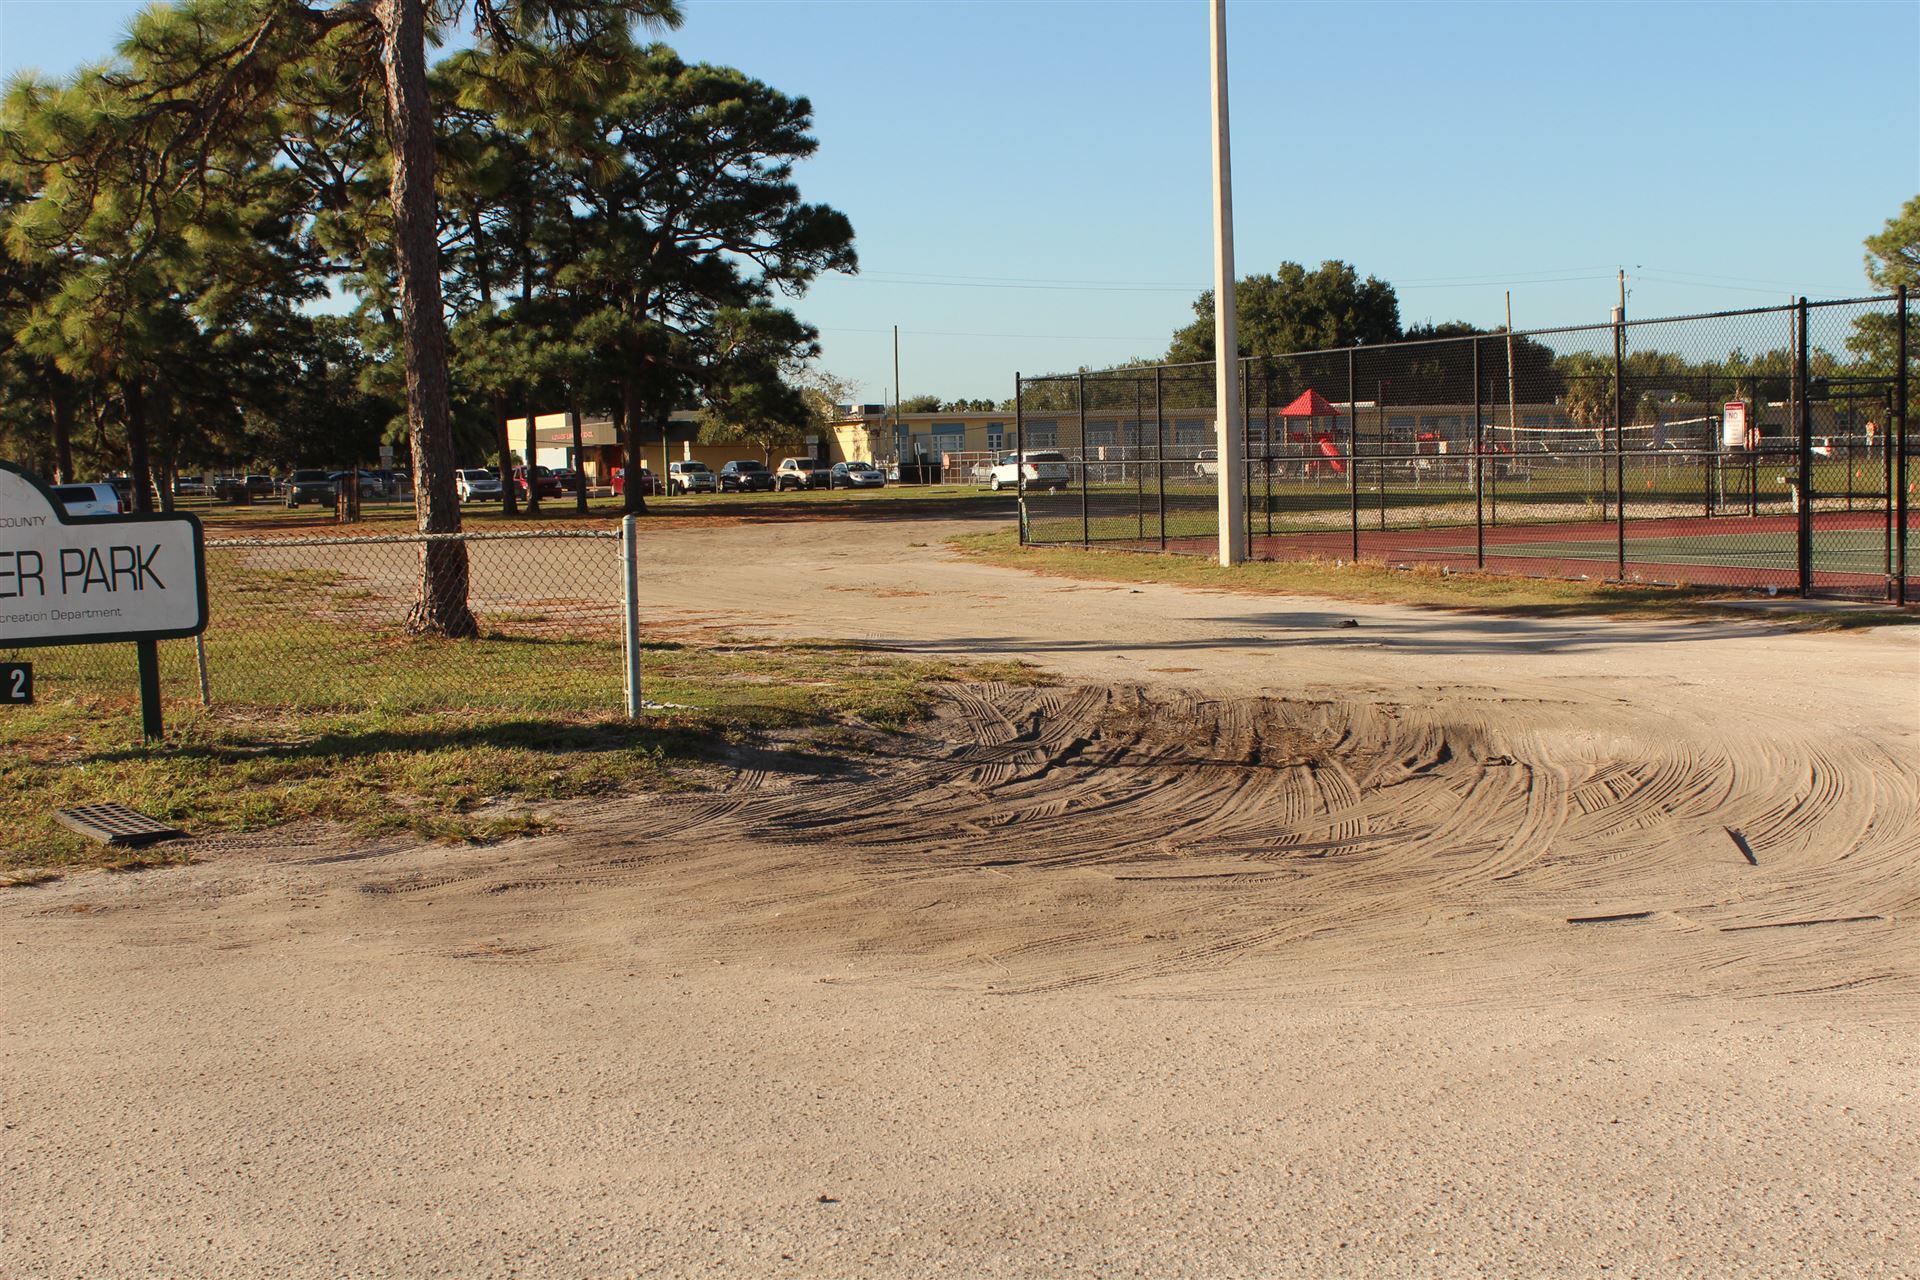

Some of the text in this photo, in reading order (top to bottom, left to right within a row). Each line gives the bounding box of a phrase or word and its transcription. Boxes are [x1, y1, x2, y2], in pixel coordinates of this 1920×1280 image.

[0, 516, 47, 528] COUNTY
[60, 544, 166, 595] PARK
[51, 608, 122, 621] Department
[11, 669, 25, 698] 2
